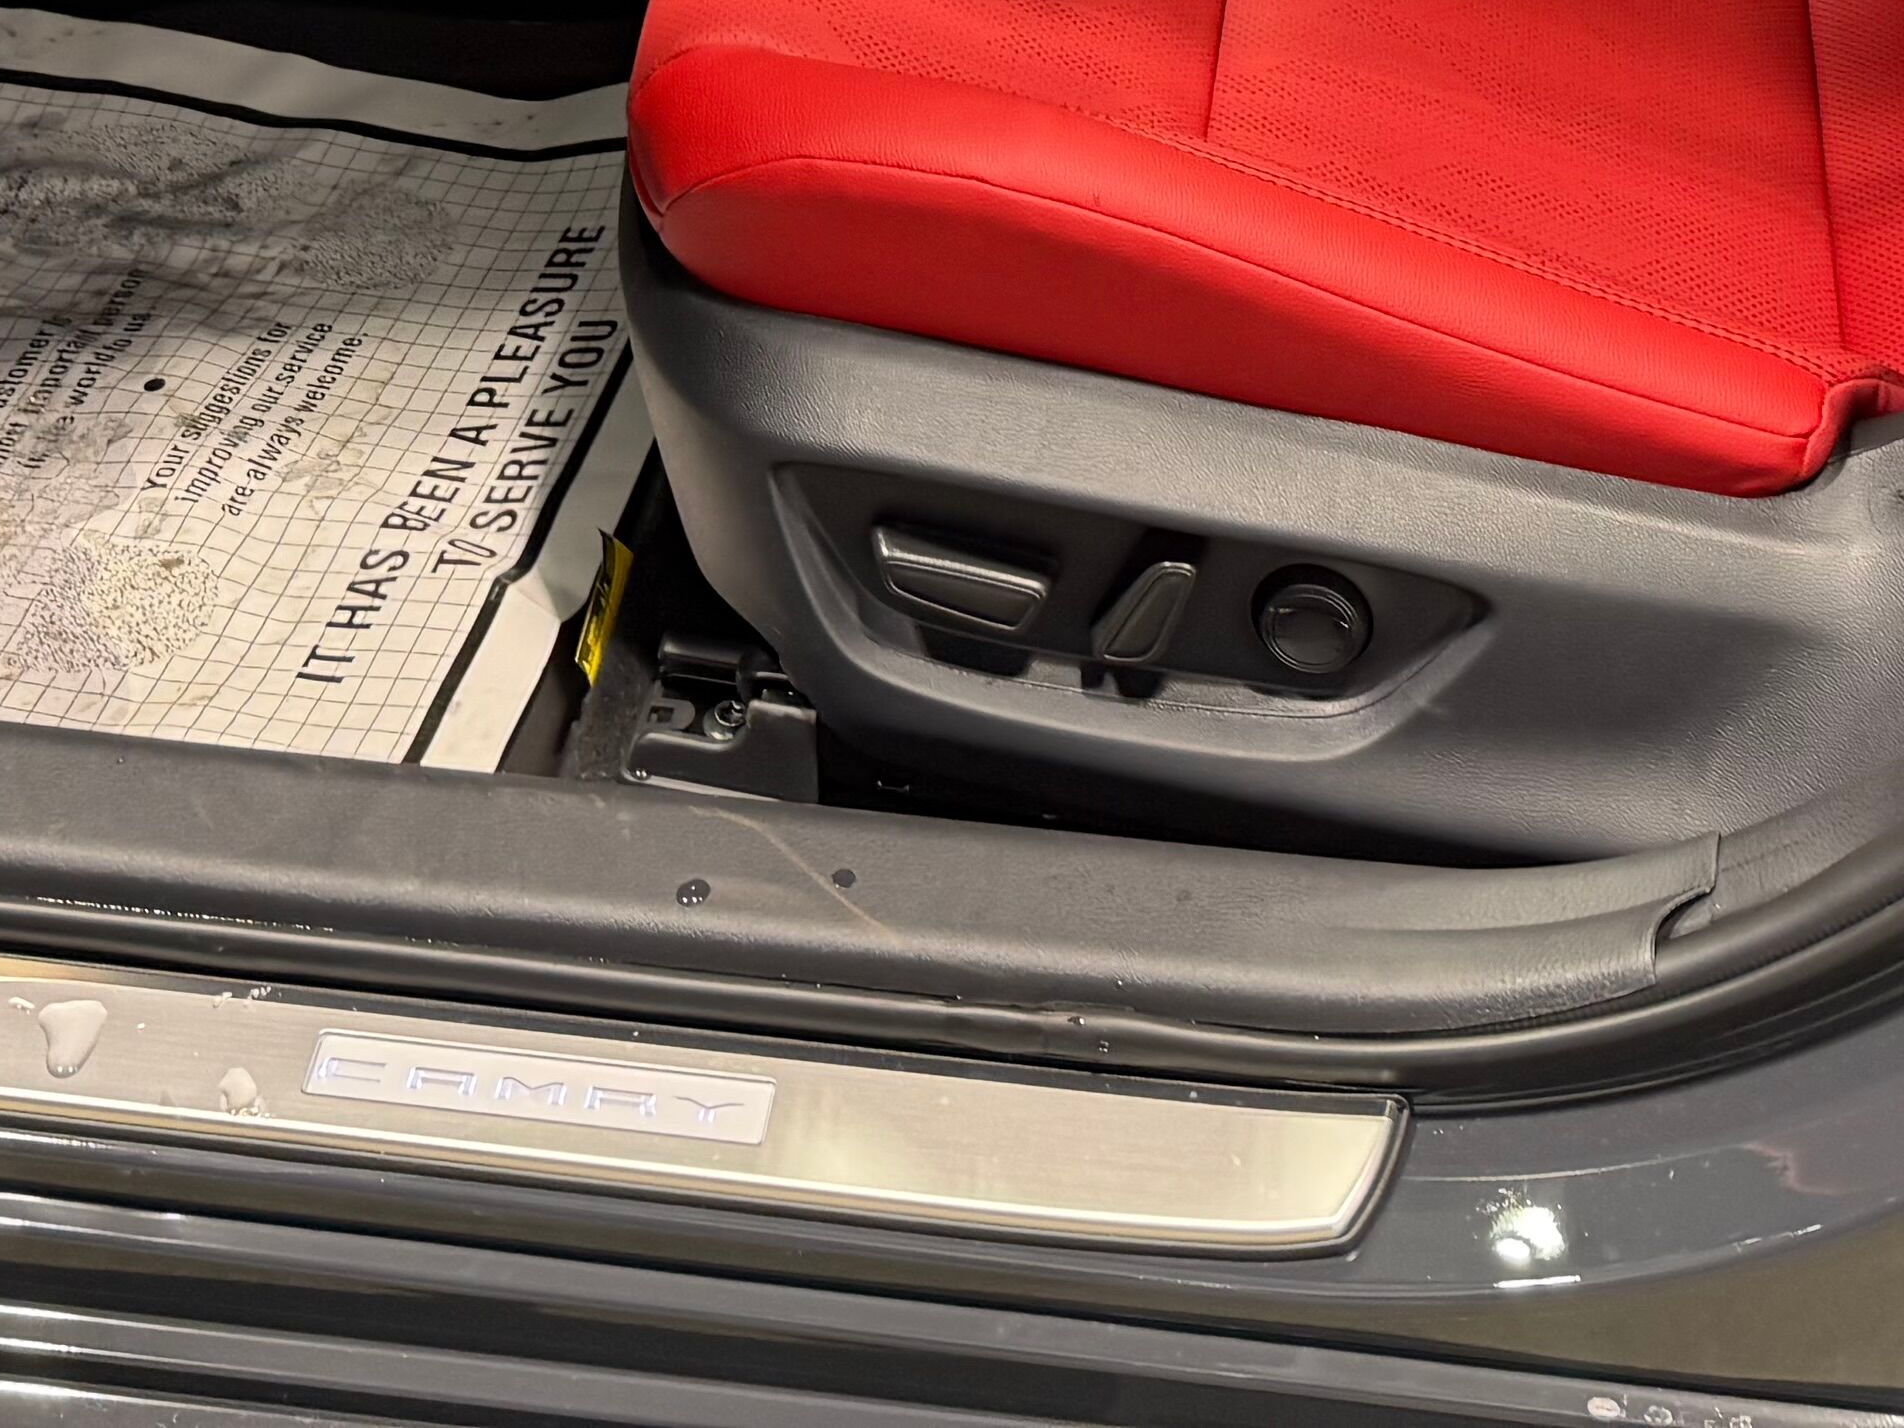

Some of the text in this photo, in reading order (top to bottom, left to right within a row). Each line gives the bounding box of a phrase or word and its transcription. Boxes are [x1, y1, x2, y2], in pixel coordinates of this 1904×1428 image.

[18, 328, 103, 415] important
[93, 268, 148, 327] person
[64, 351, 116, 408] world
[102, 338, 133, 354] to
[141, 322, 292, 491] Your suggestions for
[174, 323, 333, 502] improving our service
[222, 332, 369, 516] are always welcome.
[296, 225, 606, 683] IT HAS BEEN A PLEASURE
[431, 319, 619, 573] TO SERVE YOU
